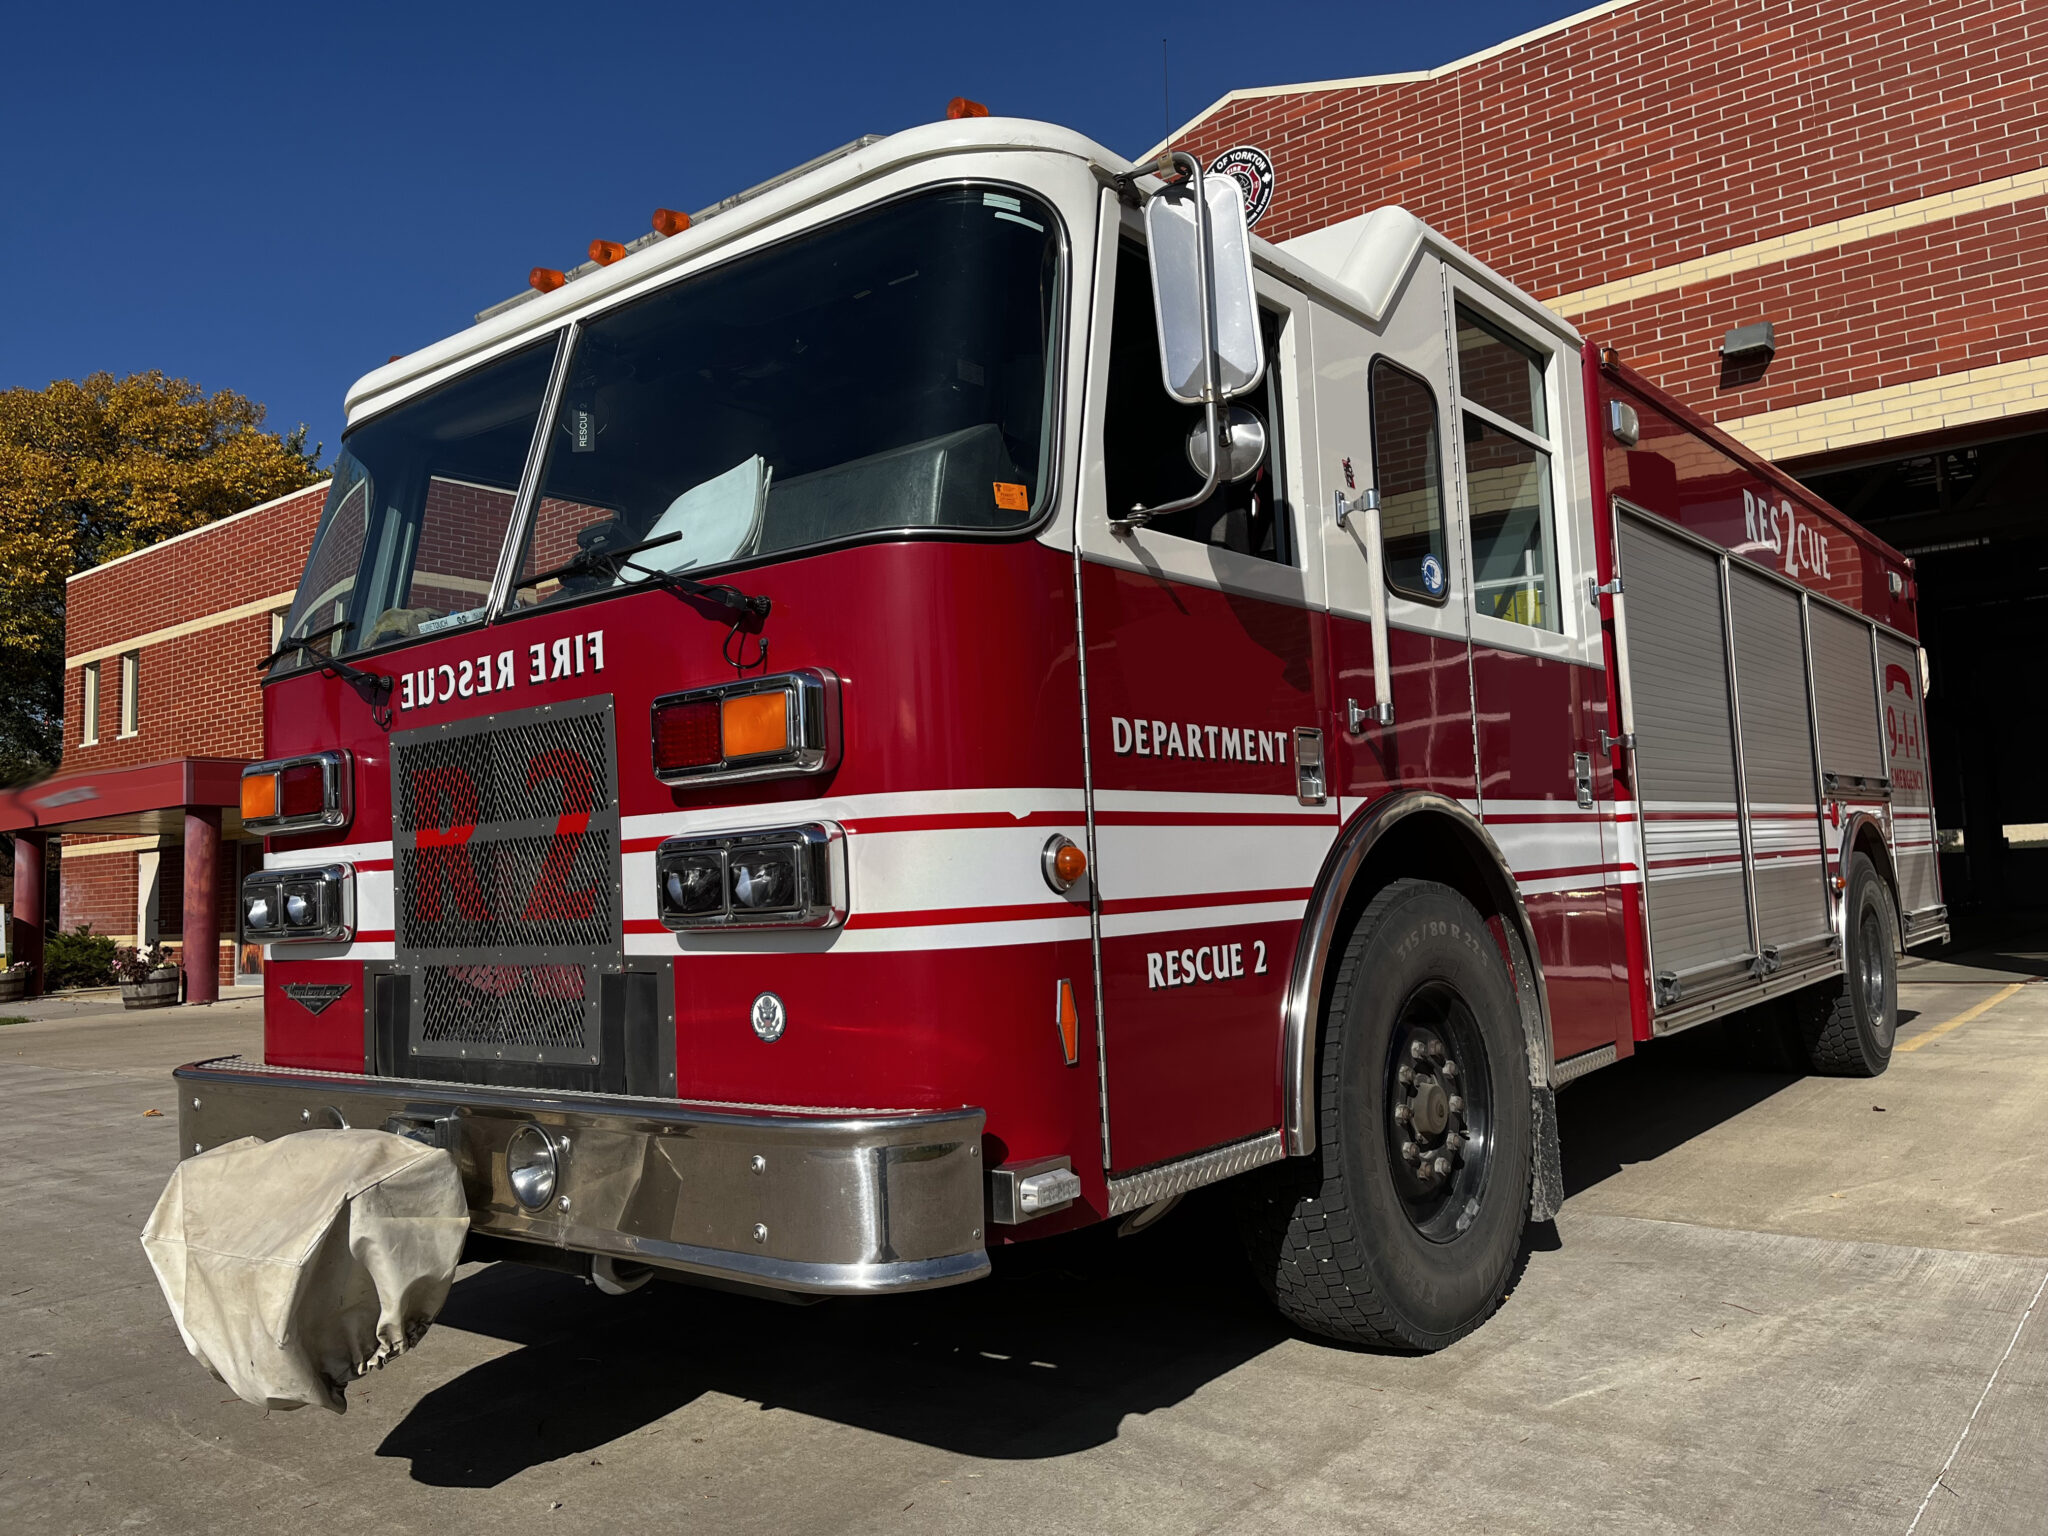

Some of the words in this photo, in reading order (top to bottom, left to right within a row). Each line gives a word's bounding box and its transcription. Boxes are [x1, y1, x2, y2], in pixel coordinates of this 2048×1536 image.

[1216, 157, 1228, 170] OF
[1229, 151, 1267, 171] YORKTON
[579, 411, 588, 447] RESCUE
[419, 619, 448, 632] SURETOUCH
[1111, 716, 1287, 764] DEPARTMENT
[1890, 767, 1924, 790] EMERGENCY
[1146, 943, 1244, 989] RESCUE
[1253, 940, 1267, 975] 2
